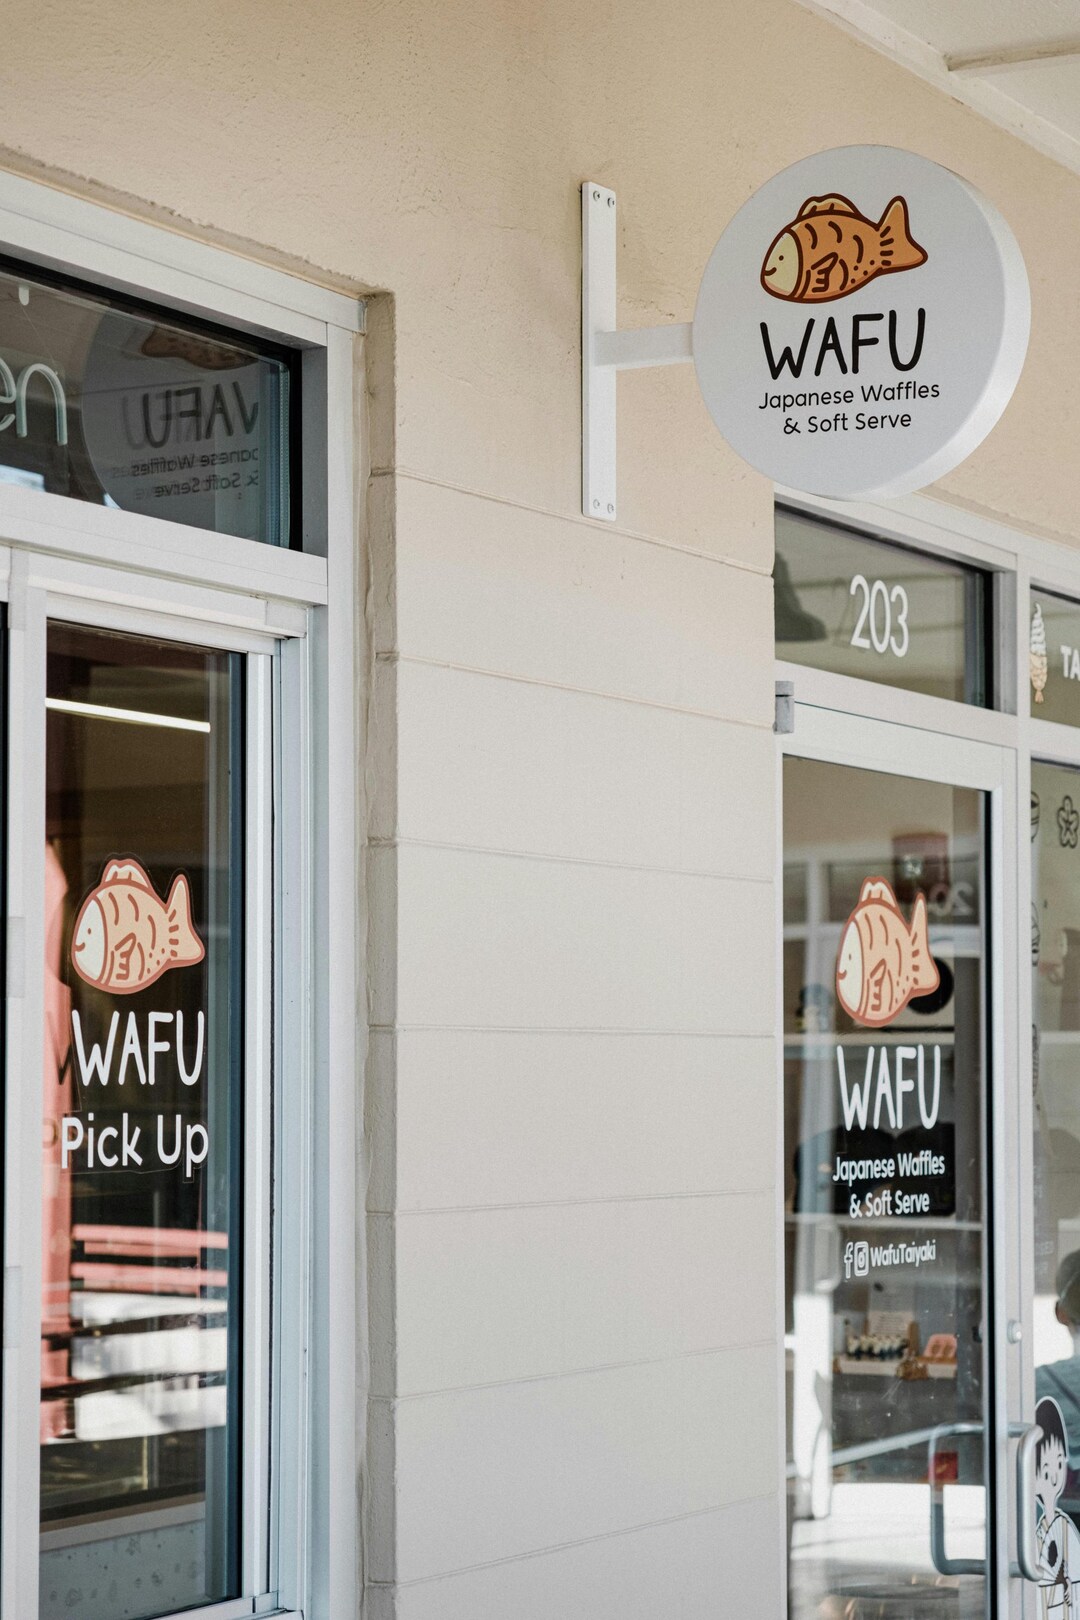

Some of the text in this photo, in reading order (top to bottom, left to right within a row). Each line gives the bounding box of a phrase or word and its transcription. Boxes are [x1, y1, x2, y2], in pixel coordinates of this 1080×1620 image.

[759, 307, 926, 380] WAFU
[758, 381, 940, 412] Japanese Waffles
[783, 411, 912, 435] & Soft Serve
[850, 574, 909, 657] 203
[71, 1009, 205, 1086] WAFU
[836, 1044, 941, 1131] WAFU
[61, 1112, 209, 1178] Pick Up
[832, 1150, 945, 1187] Japanese Waffles
[849, 1189, 930, 1219] & Soft Serve
[870, 1239, 936, 1267] WafuTaiyaki
